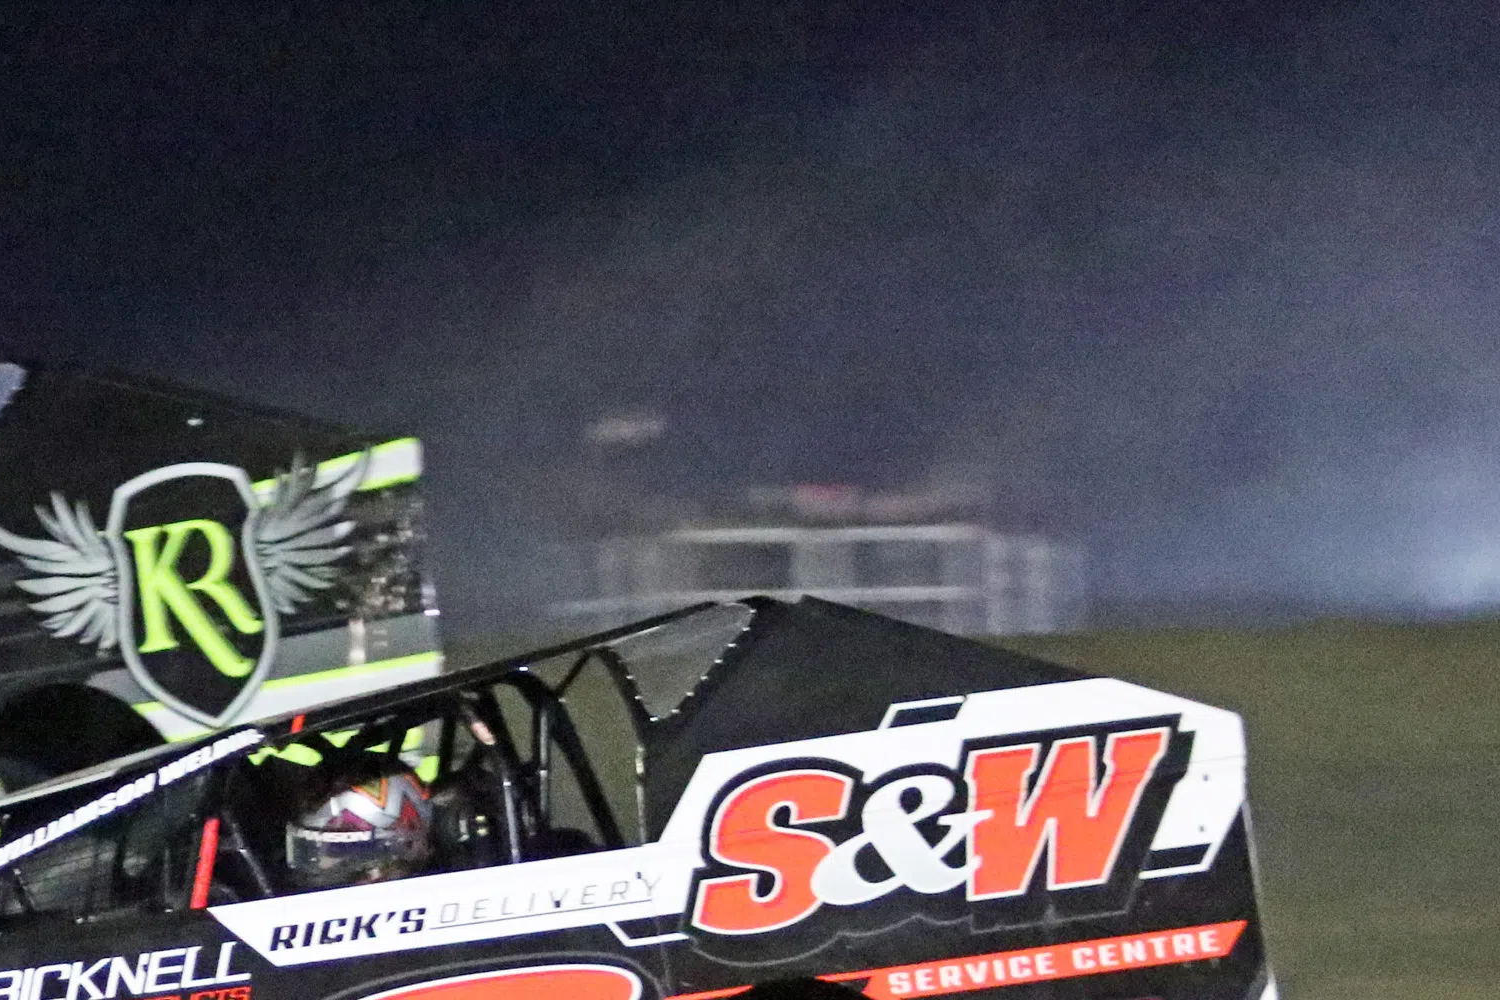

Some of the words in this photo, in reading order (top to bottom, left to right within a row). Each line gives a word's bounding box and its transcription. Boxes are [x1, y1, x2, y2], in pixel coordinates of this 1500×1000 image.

[694, 724, 1174, 936] S&W
[268, 906, 429, 953] RICK'S
[438, 872, 661, 925] DELIVERY
[887, 956, 1056, 999] SERVICE
[1071, 929, 1223, 969] CENTRE
